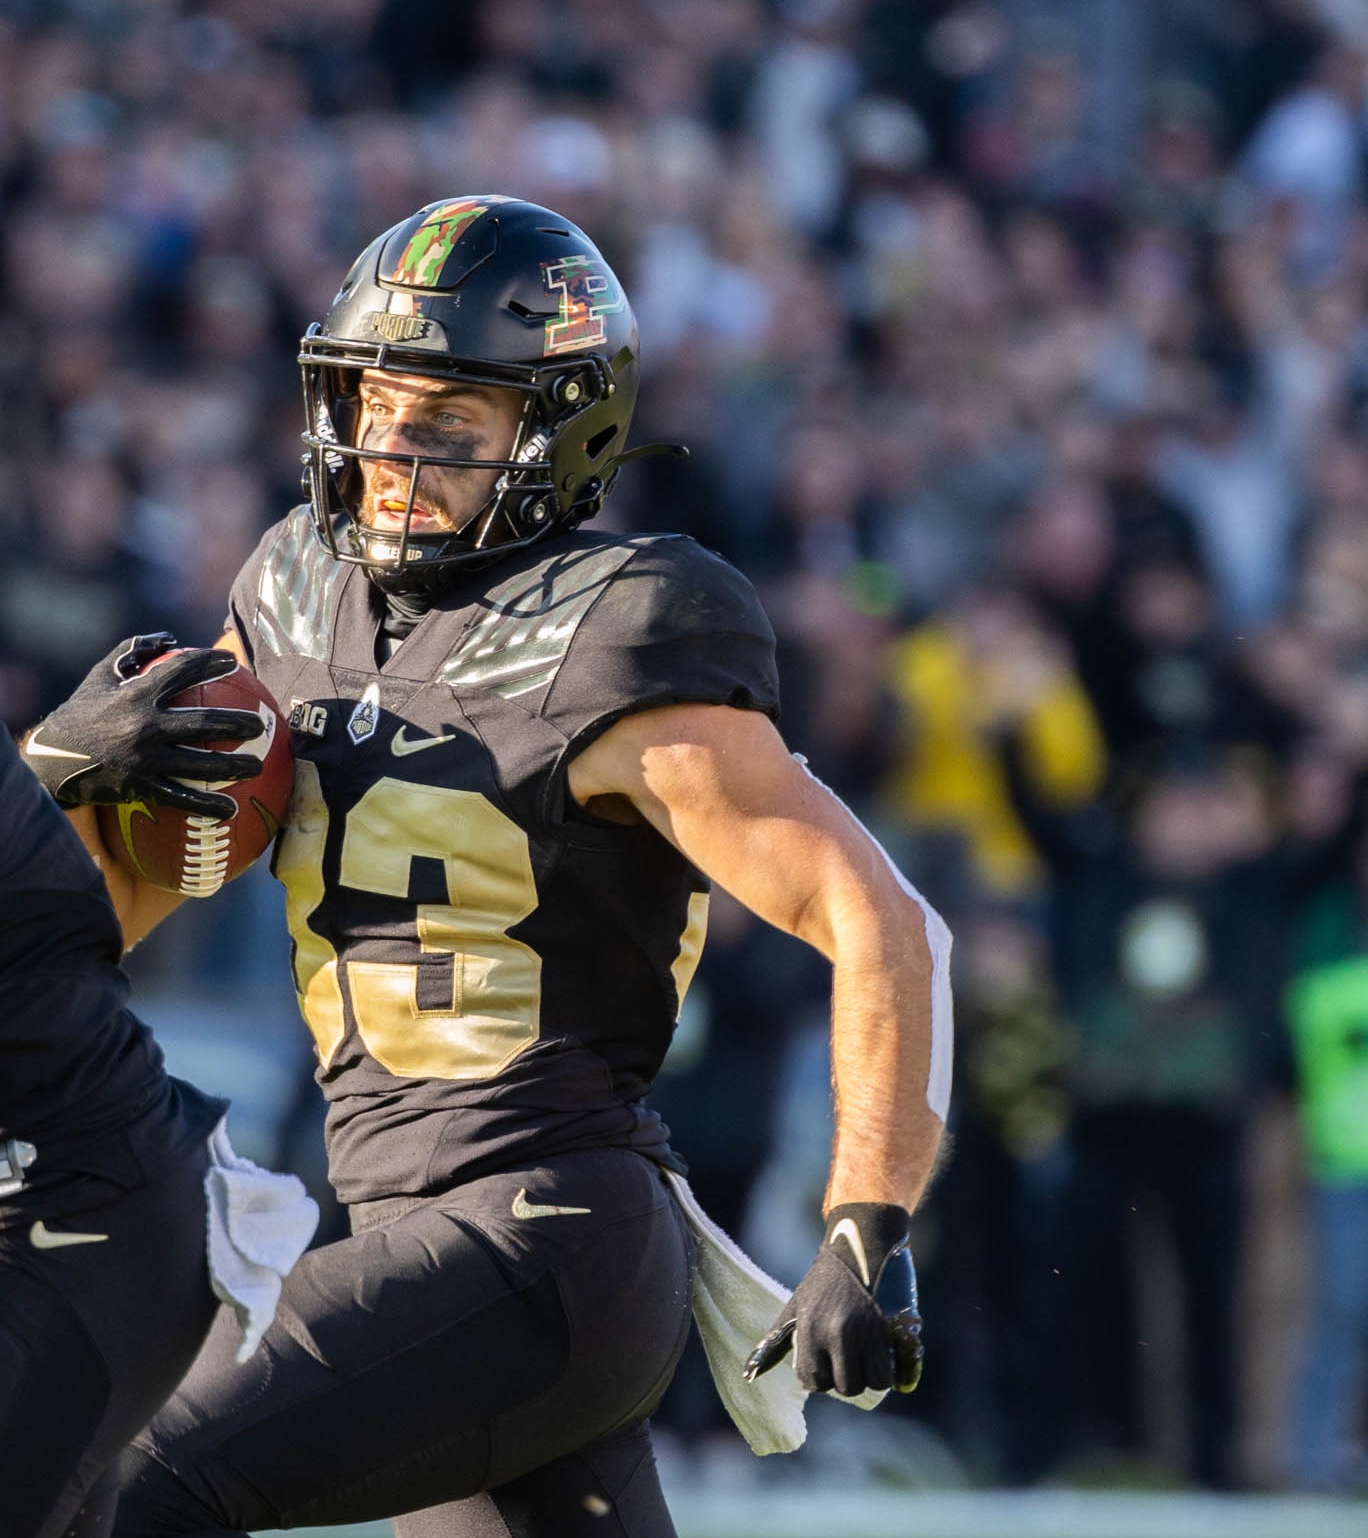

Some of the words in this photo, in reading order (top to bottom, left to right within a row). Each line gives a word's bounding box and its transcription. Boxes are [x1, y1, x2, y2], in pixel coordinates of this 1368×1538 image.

[538, 255, 624, 356] P
[371, 312, 425, 341] PURDUE
[406, 548, 423, 561] UP
